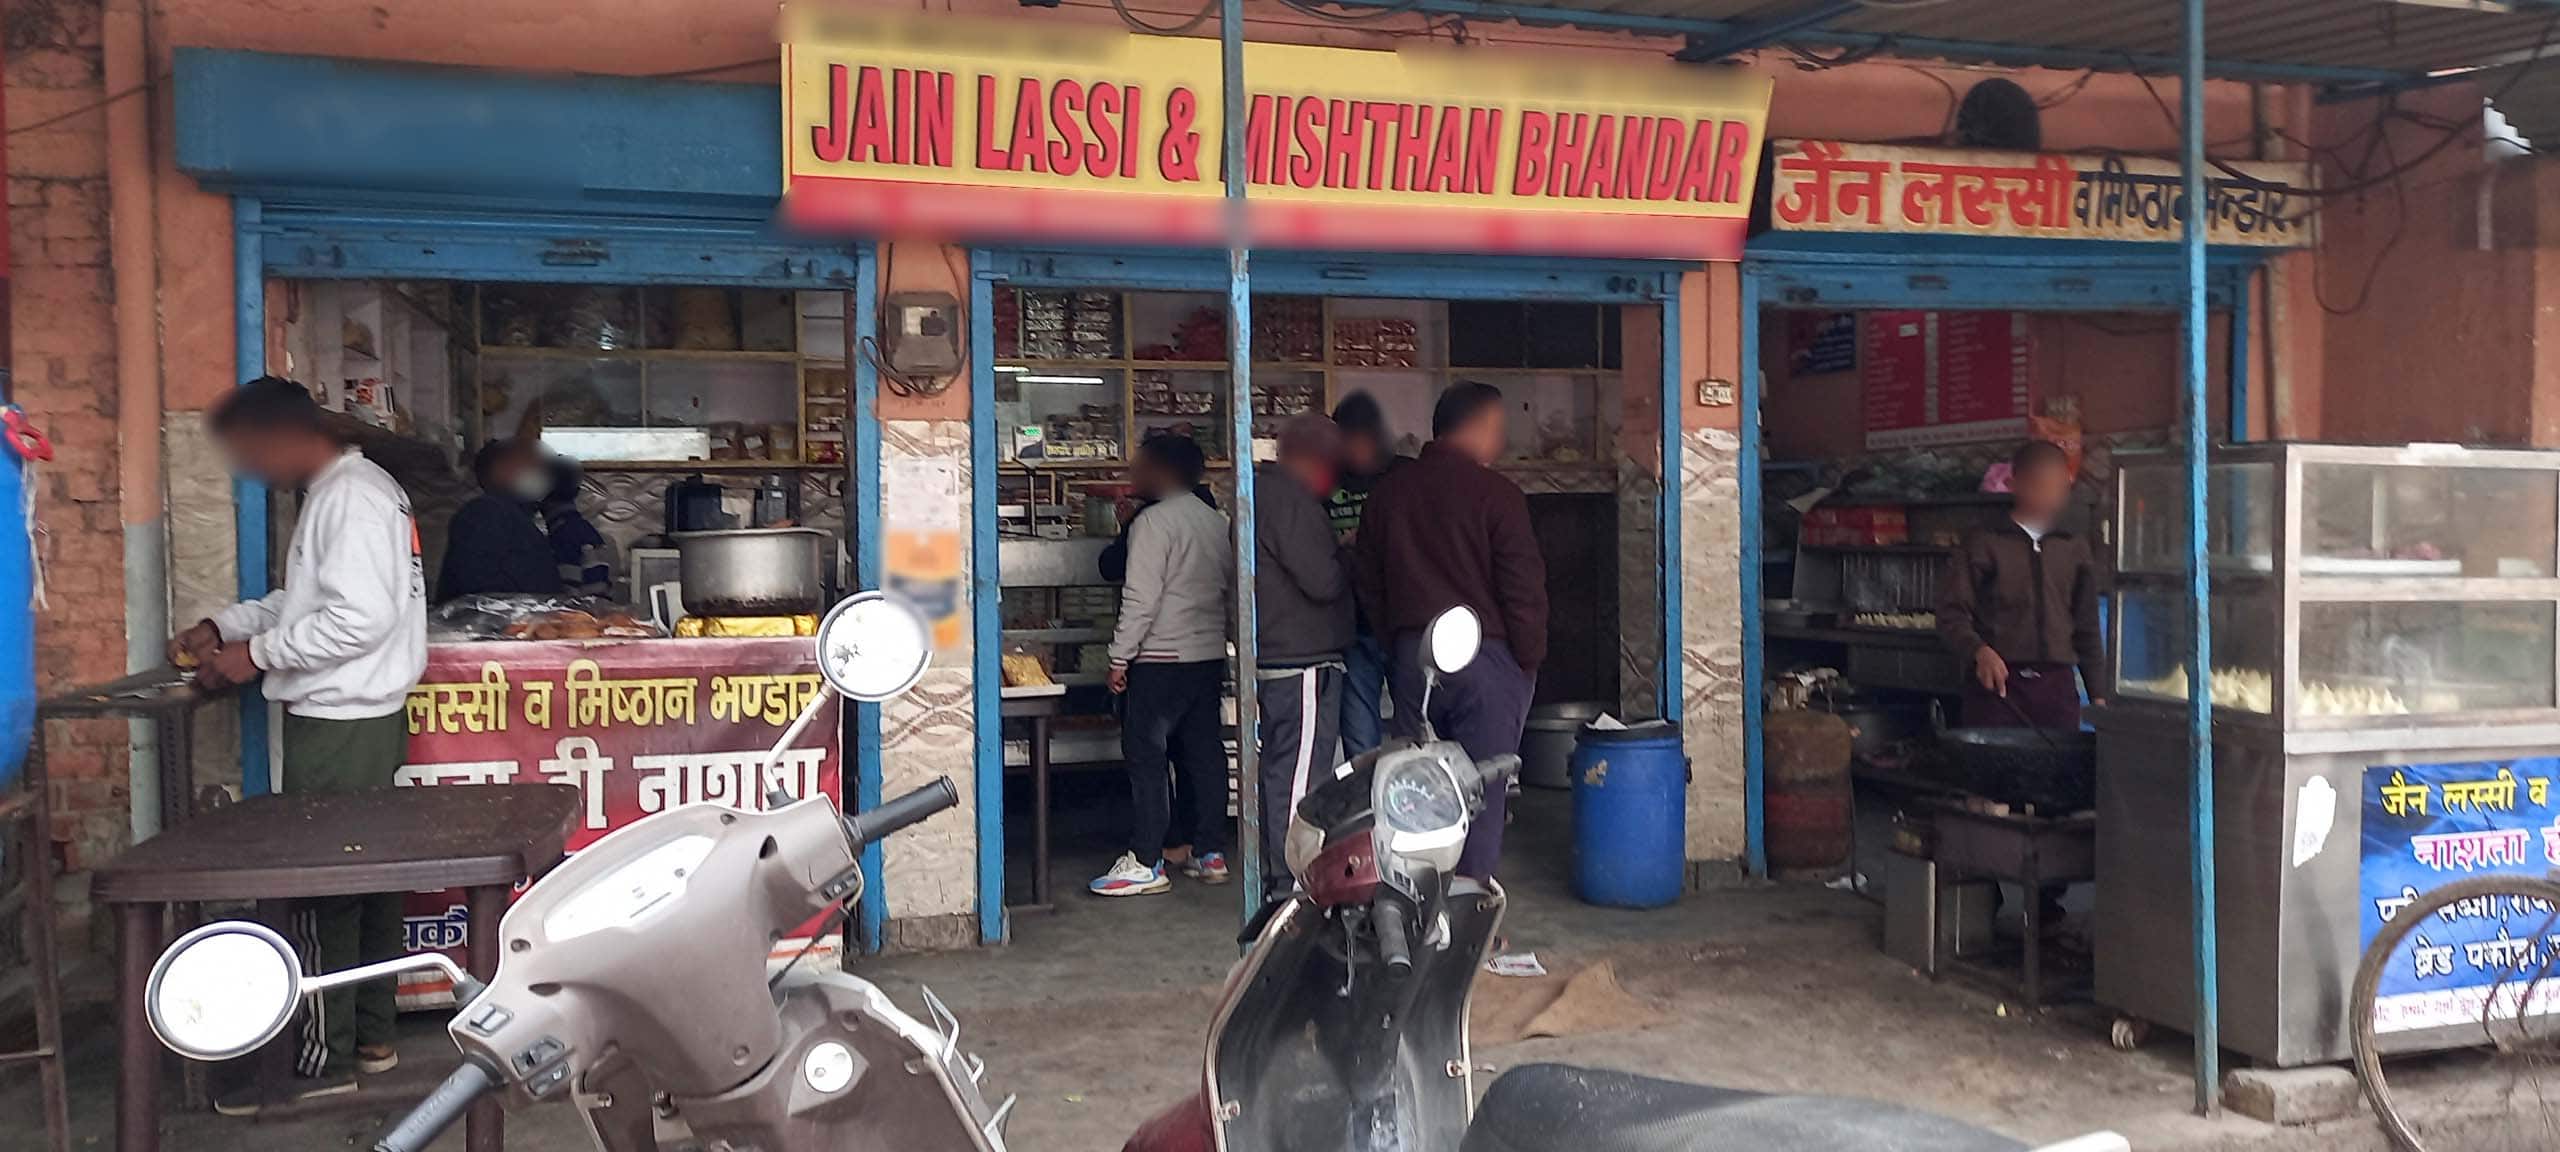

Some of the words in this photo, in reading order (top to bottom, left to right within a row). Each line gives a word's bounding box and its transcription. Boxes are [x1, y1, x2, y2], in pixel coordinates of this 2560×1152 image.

[812, 63, 954, 168] JAIN
[976, 74, 1141, 179] LASSI
[1158, 87, 1201, 182] &
[1220, 94, 1503, 195] MISHTHAN
[1512, 109, 1751, 204] BHANDAR
[1775, 139, 1892, 224] जैन
[1901, 153, 2078, 229] लस्सी
[405, 660, 511, 735] लस्सी
[522, 680, 553, 729] व
[565, 657, 698, 728] मिष्ठान
[2381, 770, 2431, 817] जैन
[2441, 768, 2517, 815] लस्सी
[2527, 777, 2551, 809] व
